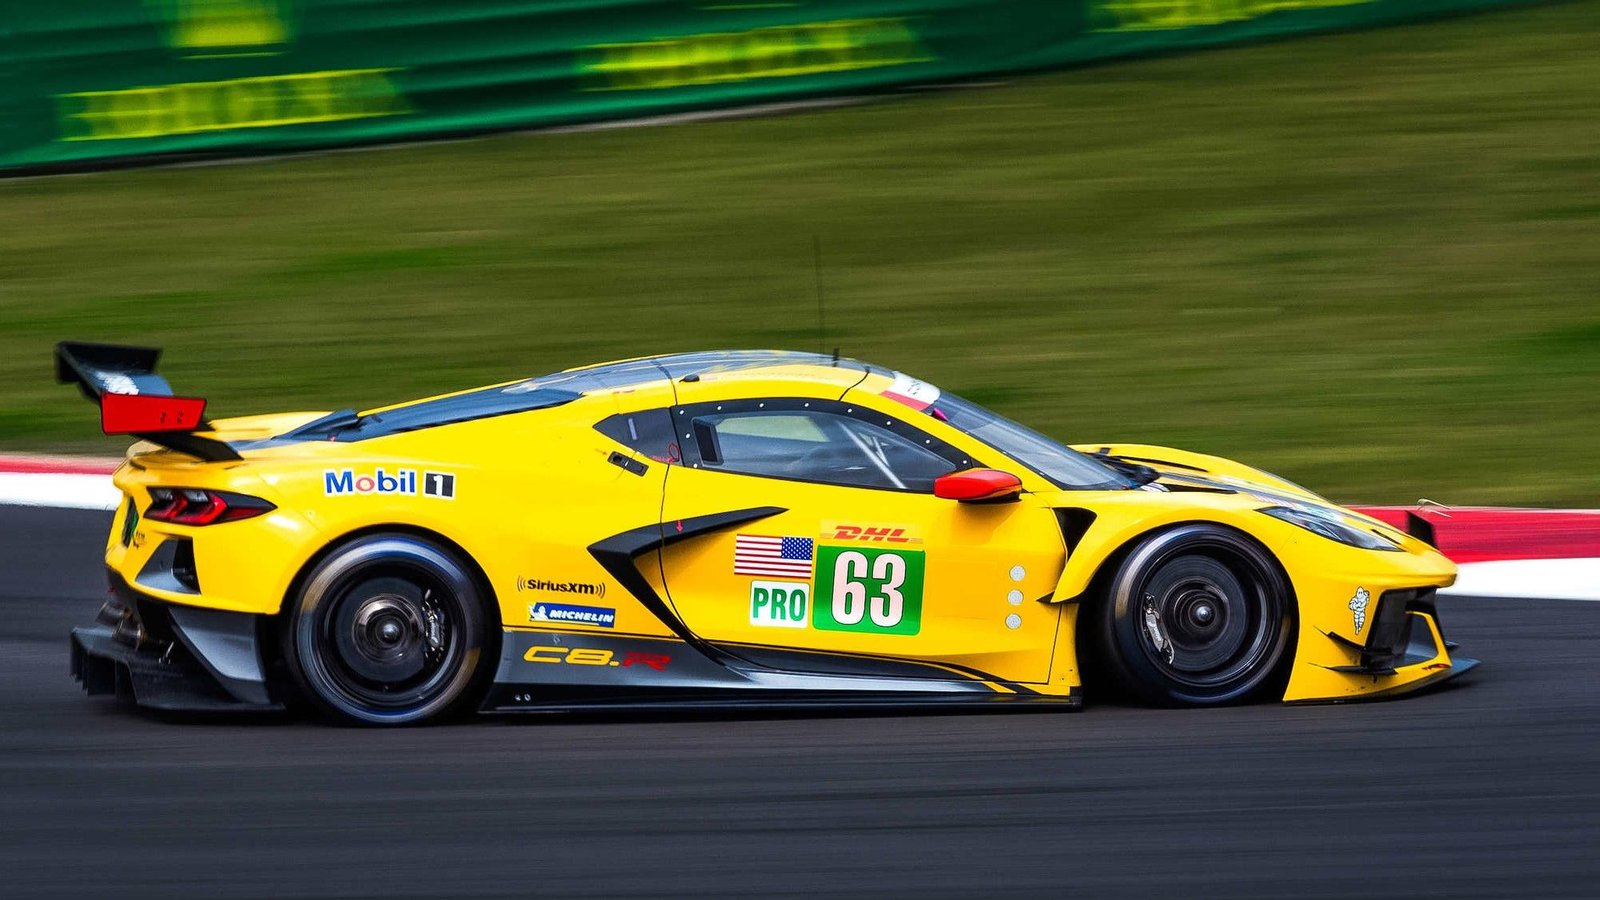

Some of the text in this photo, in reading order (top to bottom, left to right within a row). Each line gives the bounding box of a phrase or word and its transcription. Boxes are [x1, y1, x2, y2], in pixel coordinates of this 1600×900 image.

[325, 470, 416, 494] Mobil
[834, 526, 909, 543] DHL
[831, 551, 906, 627] 63
[549, 609, 614, 623] MICHELIN
[753, 587, 806, 622] PRO
[523, 645, 672, 671] C8.R
